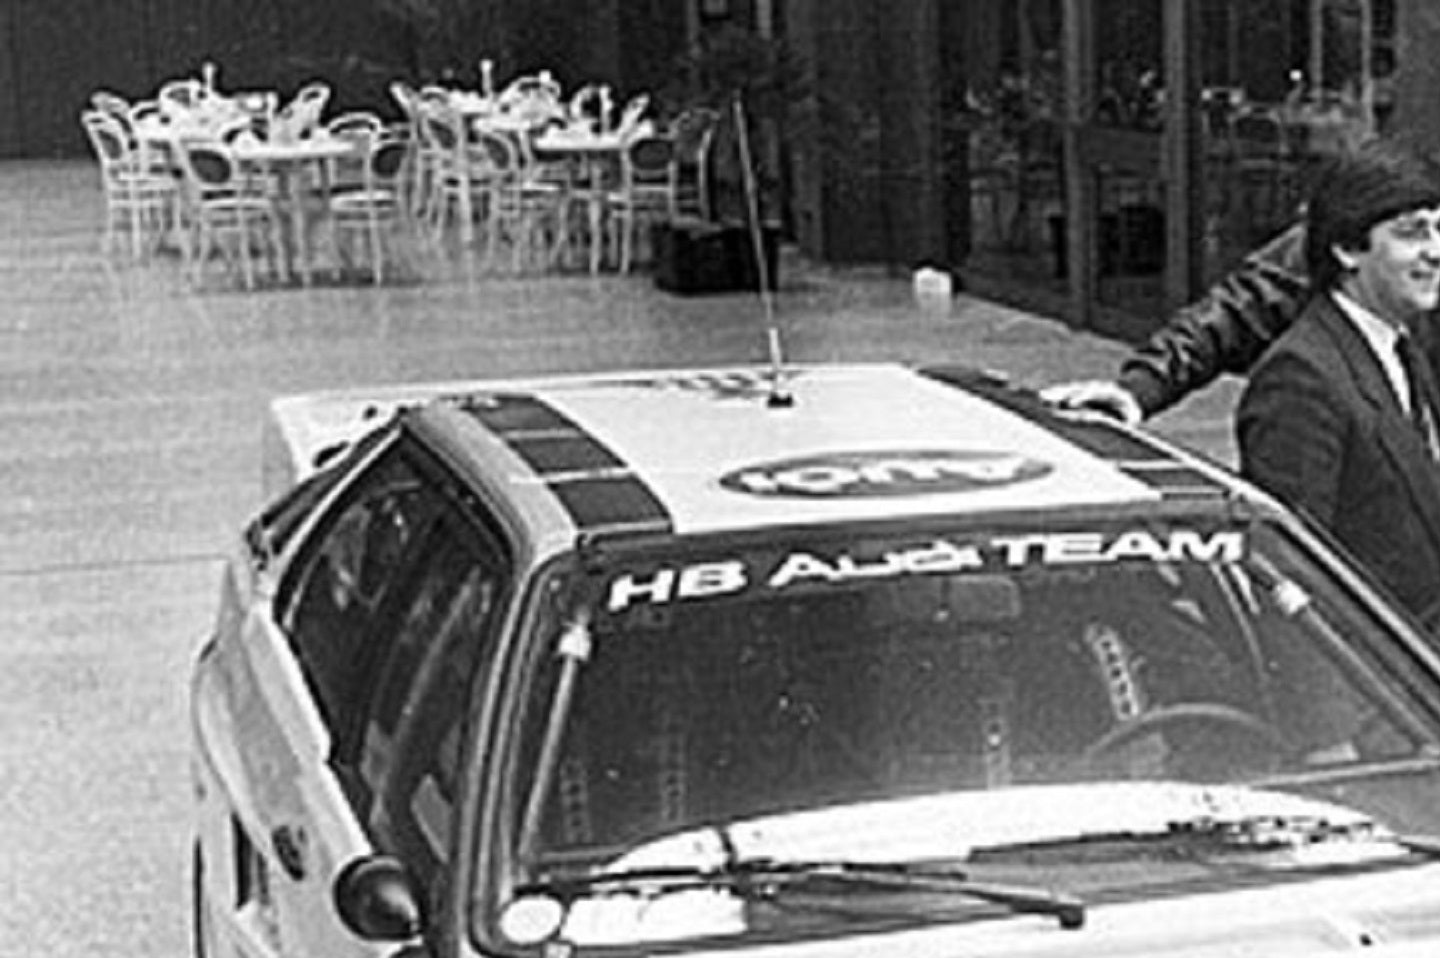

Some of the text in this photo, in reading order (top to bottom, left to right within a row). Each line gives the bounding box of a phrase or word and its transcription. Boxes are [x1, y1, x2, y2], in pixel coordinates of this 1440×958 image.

[608, 530, 1244, 612] HB Audi TEAM
